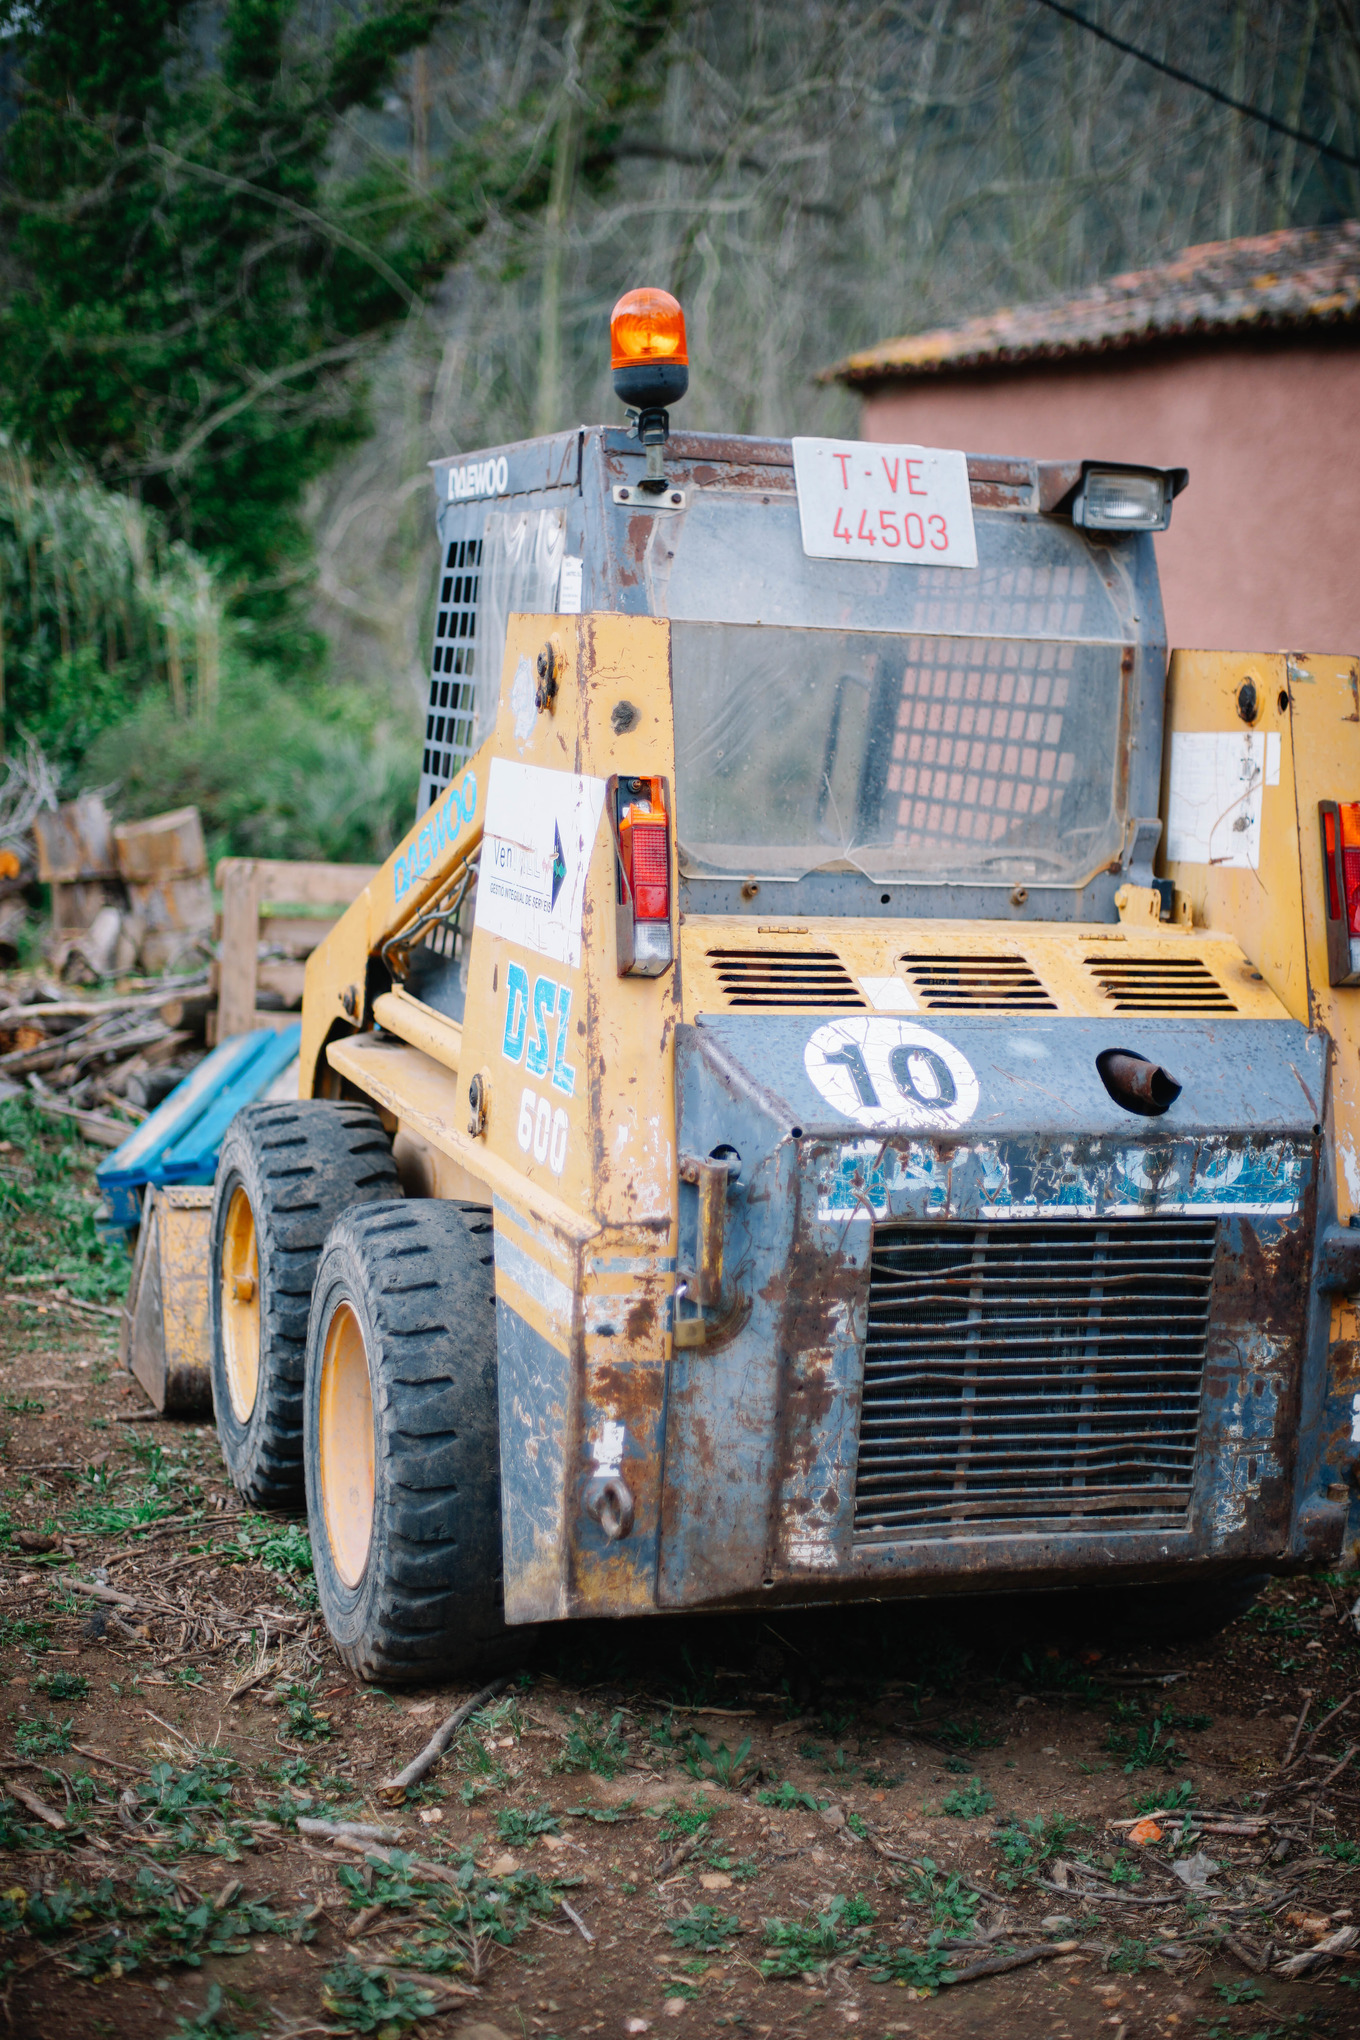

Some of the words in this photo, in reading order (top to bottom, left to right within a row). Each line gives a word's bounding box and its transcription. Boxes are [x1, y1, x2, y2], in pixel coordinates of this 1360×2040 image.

[448, 456, 508, 501] DAEWOO
[833, 506, 949, 551] 44503
[394, 770, 477, 904] DAEWOO
[502, 960, 576, 1097] DSL
[823, 1043, 958, 1110] 10
[517, 1087, 569, 1177] 600
